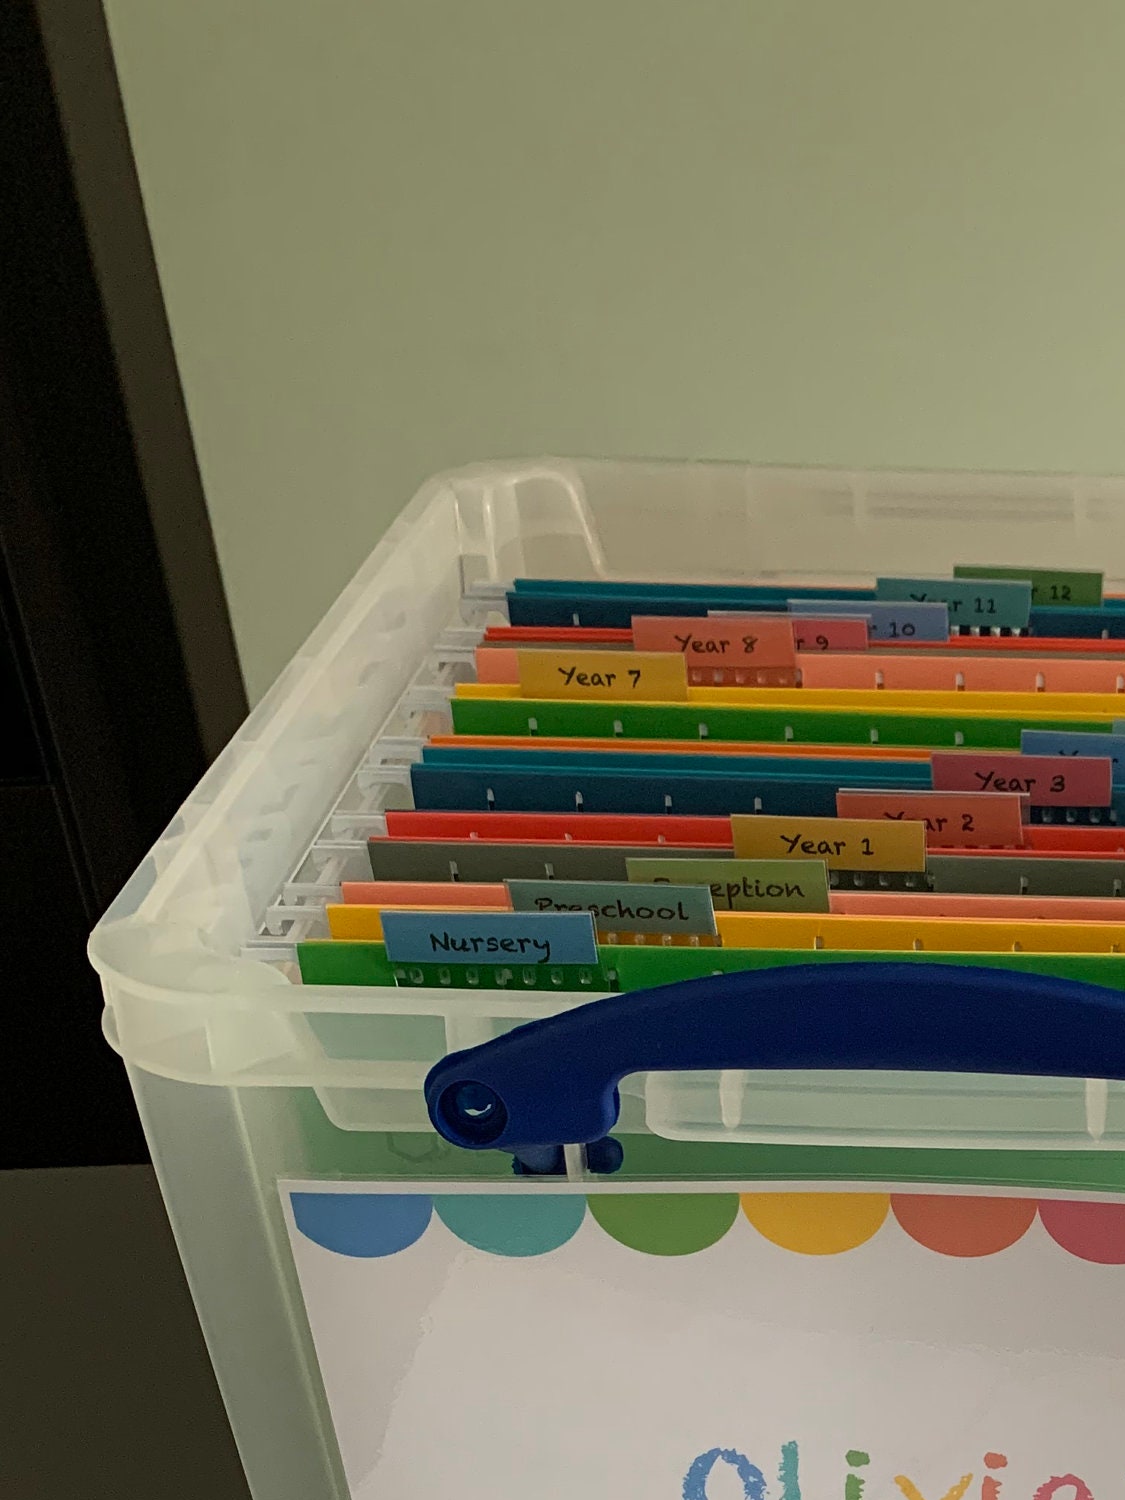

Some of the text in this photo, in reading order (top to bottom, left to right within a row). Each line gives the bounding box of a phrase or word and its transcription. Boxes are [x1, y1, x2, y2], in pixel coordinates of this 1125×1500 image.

[1052, 585, 1072, 600] 12
[910, 593, 996, 613] Yr 11
[889, 622, 916, 638] 10
[675, 634, 759, 653] Year 8
[816, 635, 829, 650] 9
[558, 666, 641, 689] Year 7
[975, 771, 1066, 793] Year 3
[883, 811, 975, 832] Yar 2
[780, 834, 874, 855] Year 1
[430, 932, 551, 964] Nursery
